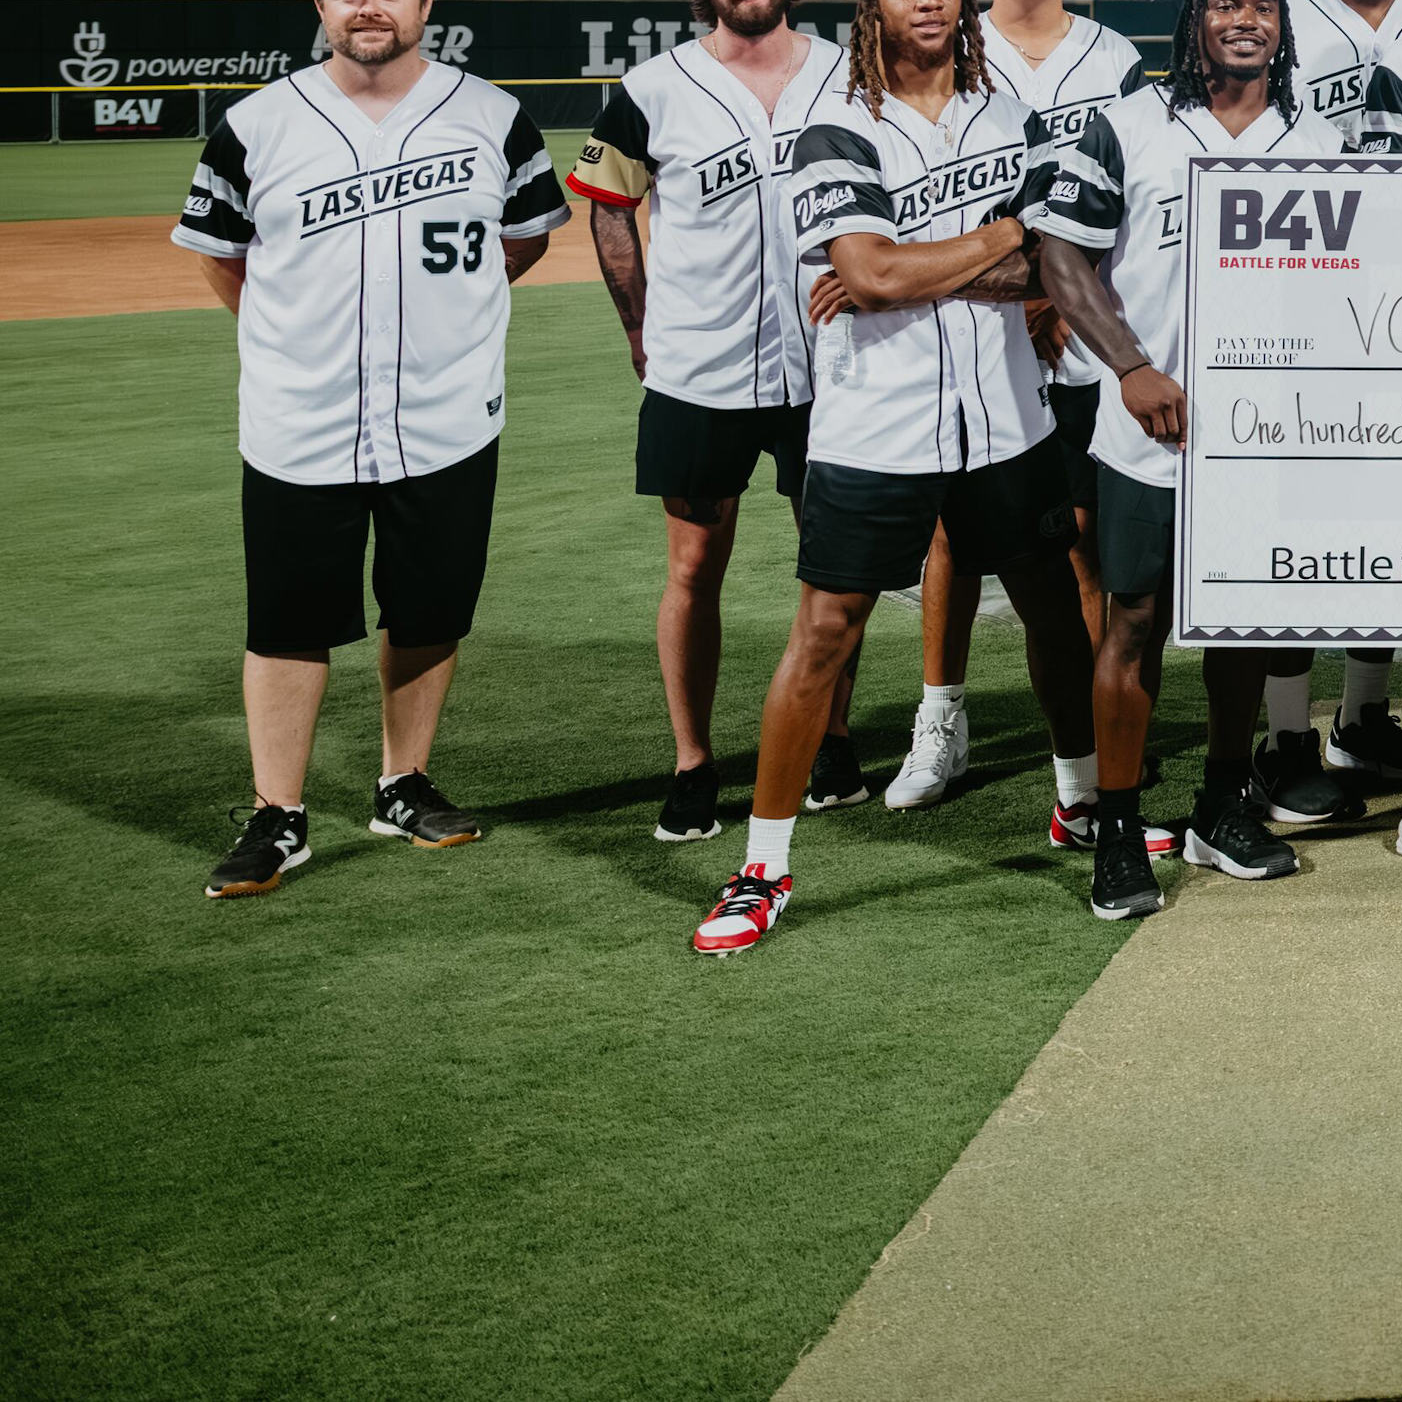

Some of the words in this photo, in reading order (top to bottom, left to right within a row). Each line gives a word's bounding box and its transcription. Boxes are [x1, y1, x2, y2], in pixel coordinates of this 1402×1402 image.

[125, 49, 293, 84] powershift
[94, 98, 164, 126] B4V
[1311, 75, 1362, 113] LAS
[1043, 102, 1112, 141] EGA
[700, 147, 752, 197] LAS
[896, 192, 931, 227] AS
[936, 151, 1025, 205] VEGAS
[301, 183, 365, 229] LAS
[372, 156, 477, 205] VEGAS
[795, 183, 857, 229] Vegas
[1219, 189, 1362, 252] B4V
[421, 220, 487, 275] 53
[1219, 256, 1274, 270] BATTLE
[1278, 256, 1308, 270] FOR
[1311, 256, 1361, 270] VEGAS
[1215, 352, 1272, 365] ORDER
[1276, 352, 1299, 365] OF
[1217, 337, 1249, 350] PAY
[1253, 337, 1275, 350] TO
[1278, 337, 1314, 350] THE
[1230, 397, 1286, 447] One
[1208, 570, 1228, 580] FOR
[1271, 546, 1394, 581] Battle
